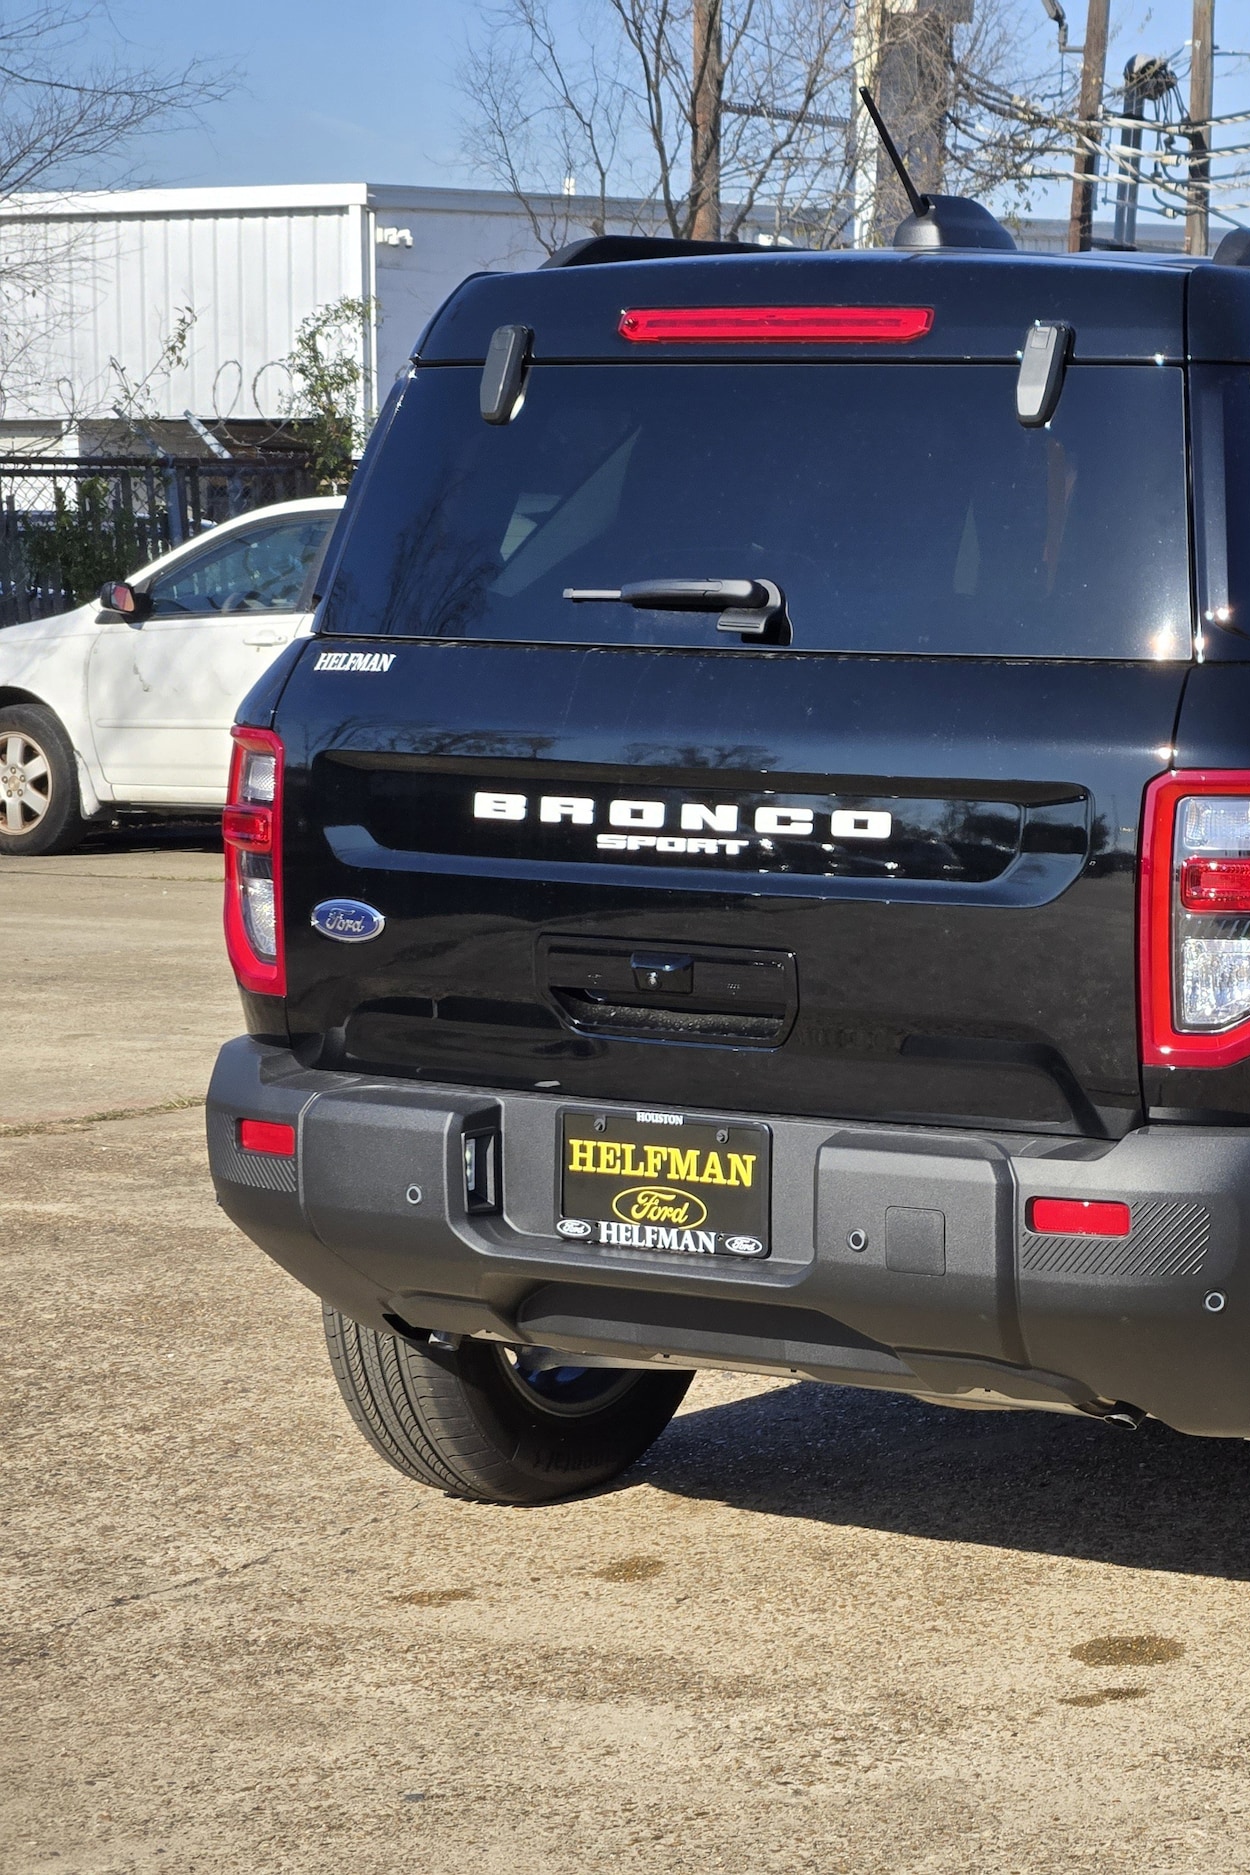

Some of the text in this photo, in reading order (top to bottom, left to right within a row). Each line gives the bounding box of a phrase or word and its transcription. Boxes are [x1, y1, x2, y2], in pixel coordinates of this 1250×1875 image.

[313, 652, 397, 673] HELFMAN
[473, 791, 893, 839] BRONCO
[596, 833, 749, 855] SPORT
[325, 907, 366, 933] Ford
[636, 1111, 684, 1126] HOUSTON
[568, 1138, 757, 1188] HELFMAN
[630, 1190, 690, 1225] Ford
[598, 1220, 718, 1255] HELFMAN
